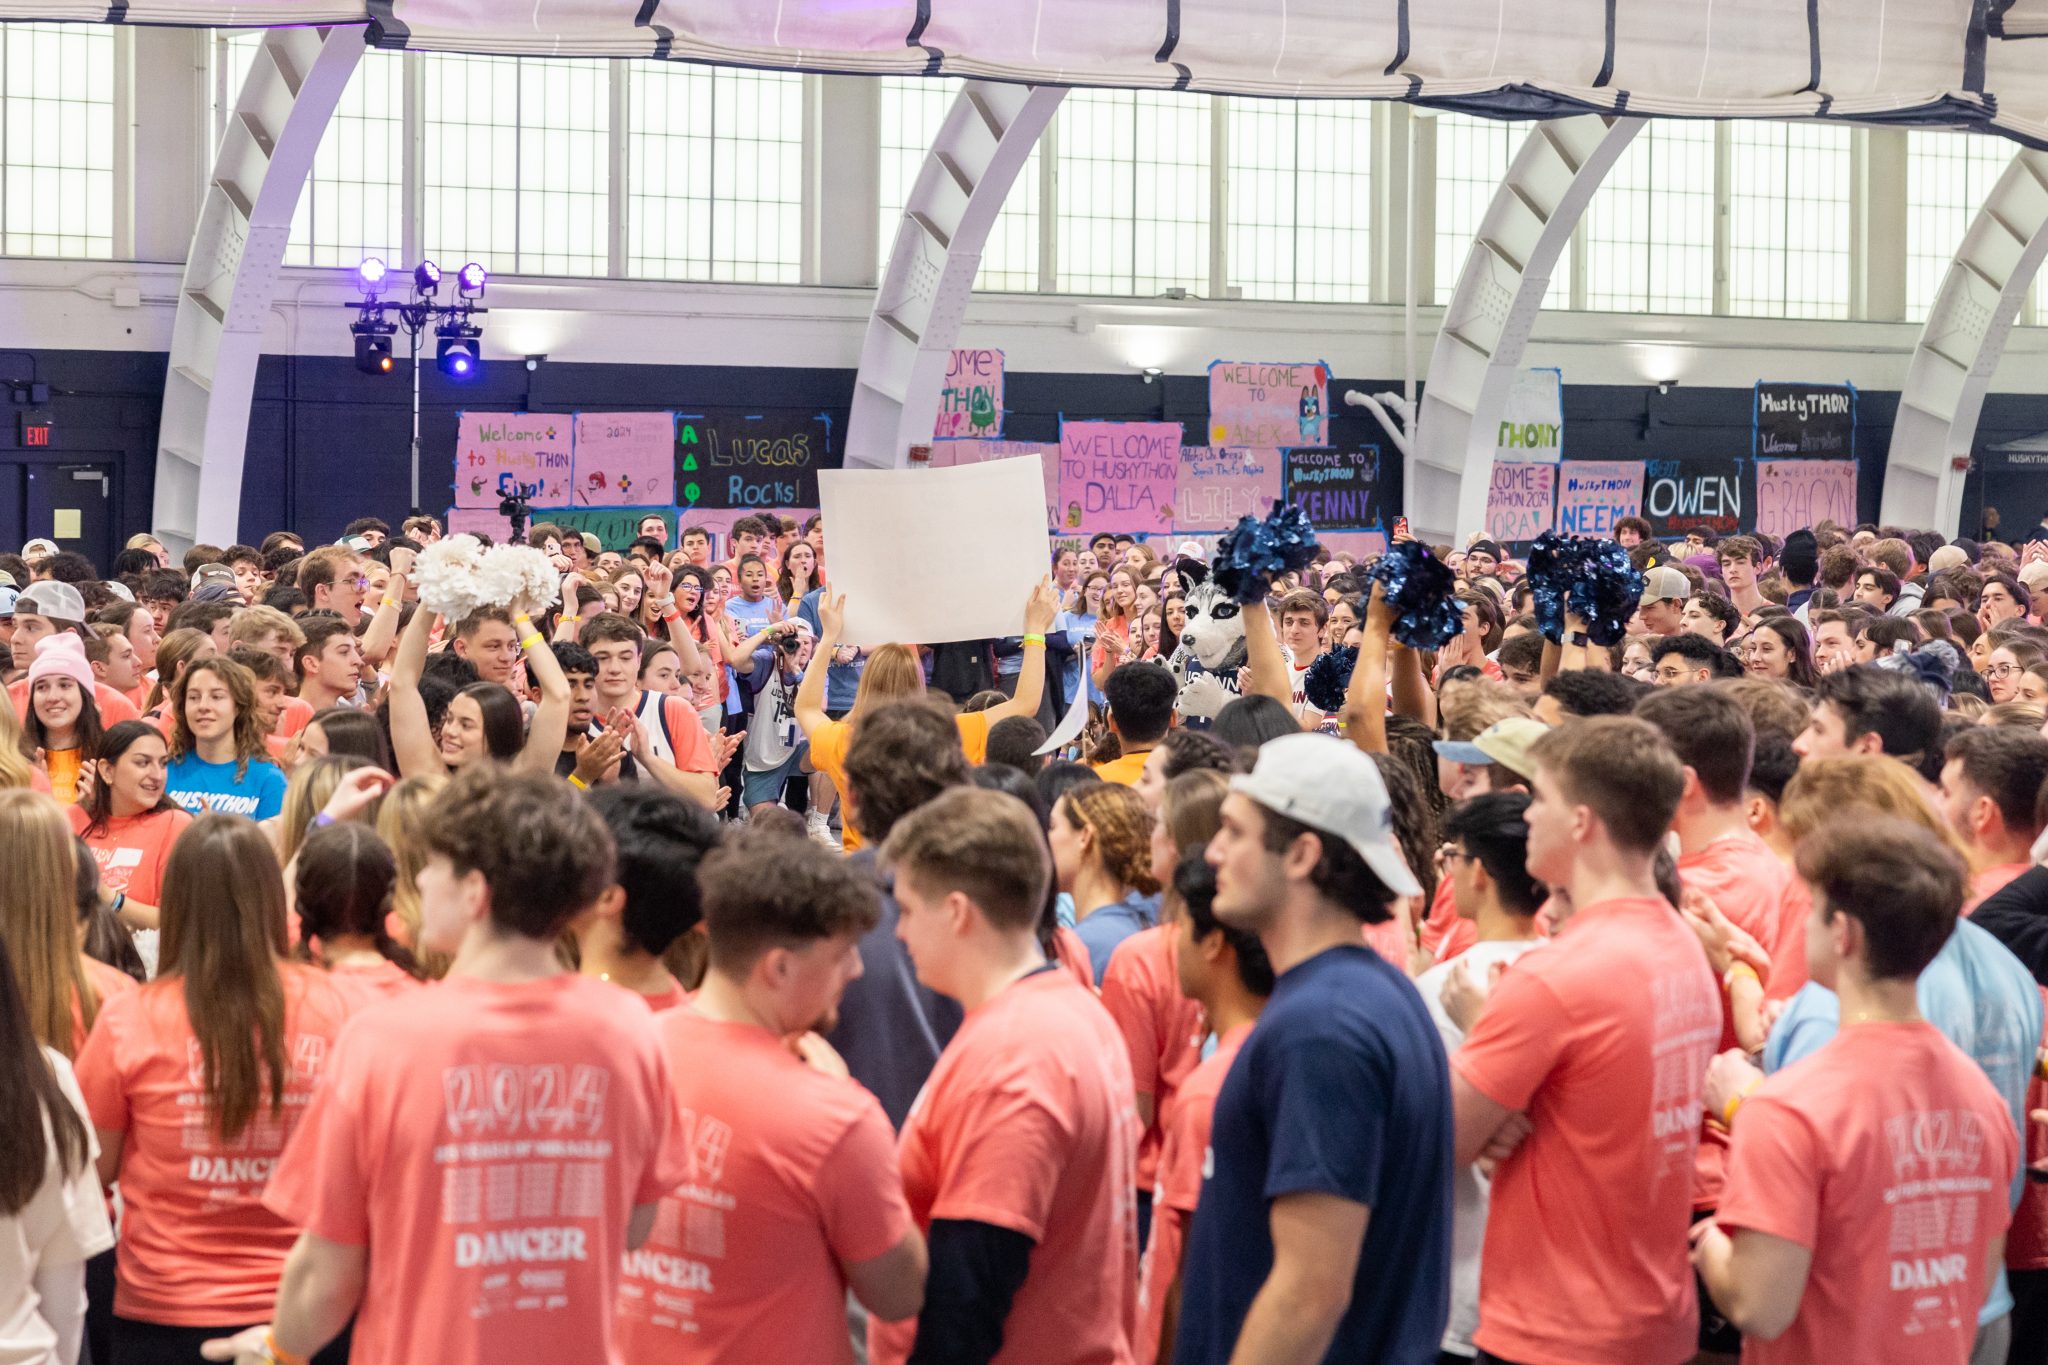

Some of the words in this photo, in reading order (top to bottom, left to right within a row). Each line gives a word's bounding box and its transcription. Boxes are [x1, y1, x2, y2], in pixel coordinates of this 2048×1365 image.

[1223, 366, 1303, 388] WELCOME
[1248, 387, 1266, 402] TO
[1760, 393, 1849, 421] HuskyTHON
[27, 426, 49, 446] EXIT
[480, 423, 543, 442] Welcome
[607, 427, 632, 438] 2024
[1233, 424, 1283, 444] ALEX
[468, 449, 485, 467] to
[1067, 434, 1175, 460] WELCOME
[1062, 459, 1085, 479] TO
[1092, 460, 1177, 480] HUSKYTHON
[1289, 454, 1341, 467] WELCOME
[1348, 453, 1365, 464] TO
[499, 472, 545, 498] Eia!
[1489, 466, 1536, 490] COME
[1085, 482, 1156, 513] DALIA
[1183, 486, 1261, 524] LILY
[1295, 489, 1370, 520] KENNY
[1649, 476, 1741, 517] OWEN
[455, 1226, 587, 1268] DANCER
